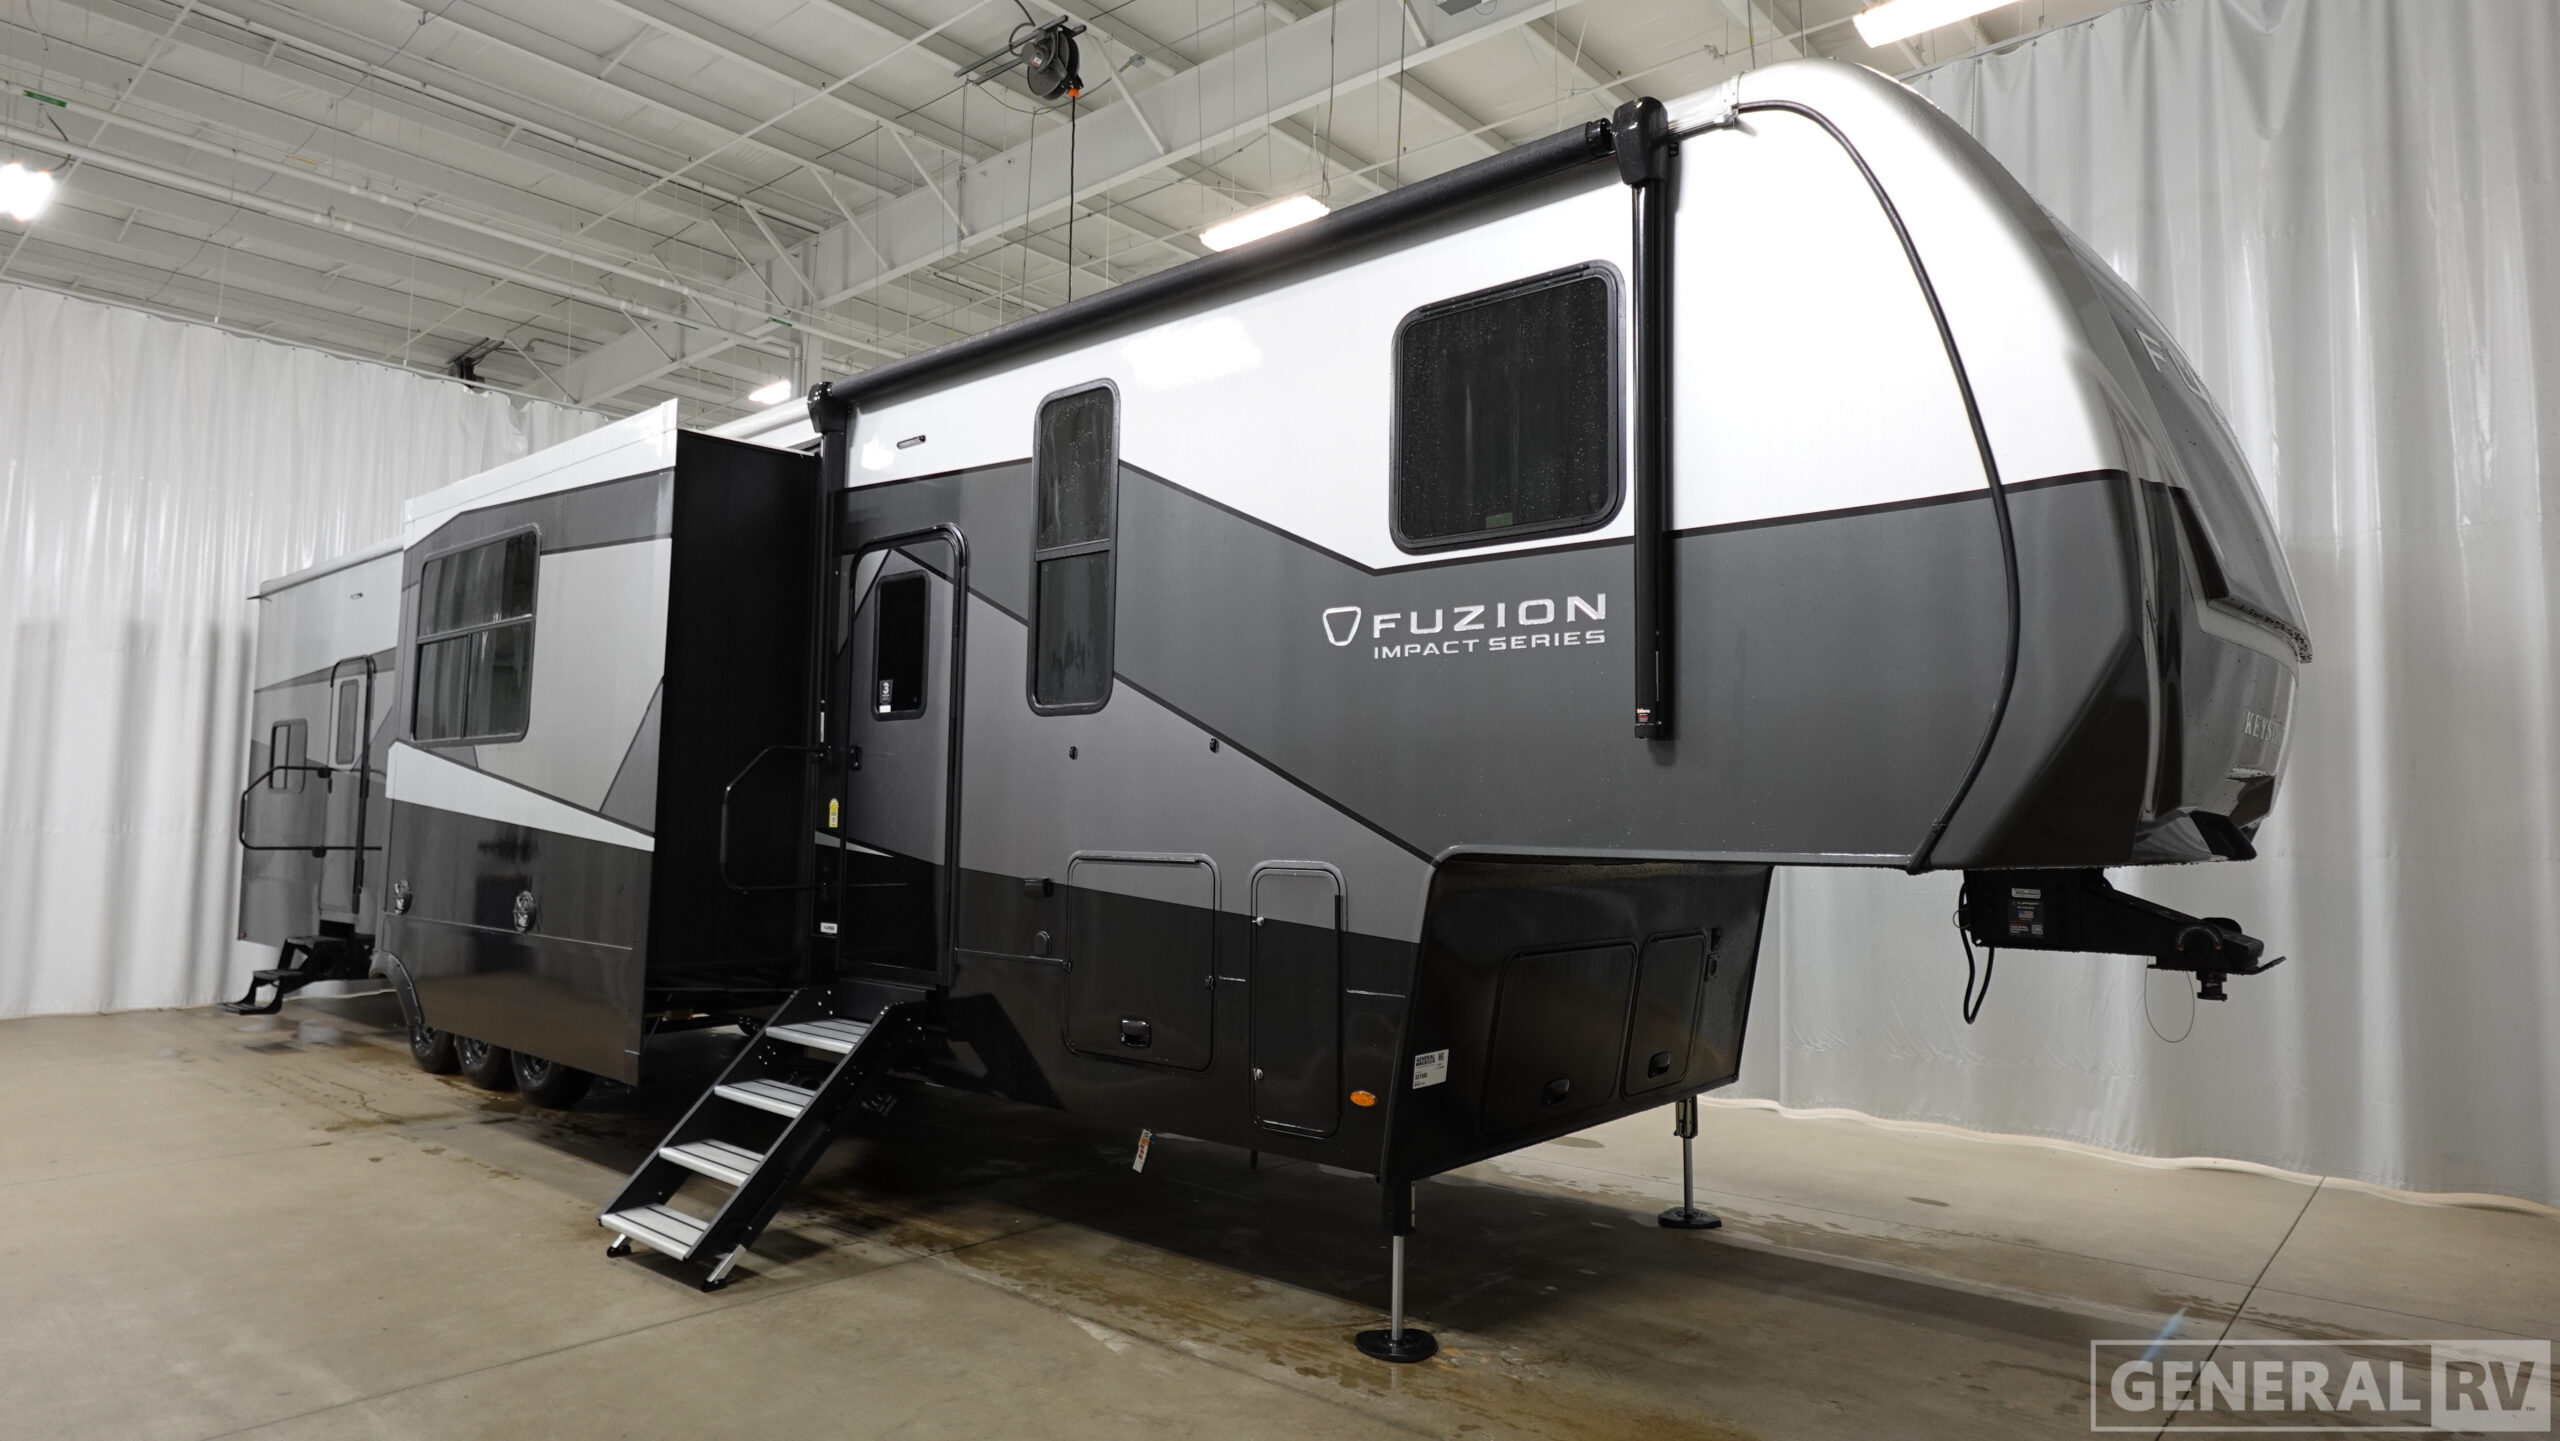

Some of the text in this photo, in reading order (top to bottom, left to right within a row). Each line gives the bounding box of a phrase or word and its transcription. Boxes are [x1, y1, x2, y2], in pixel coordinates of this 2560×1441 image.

[1372, 593, 1607, 639] FUZION
[1373, 629, 1606, 660] IMPACT SERIES
